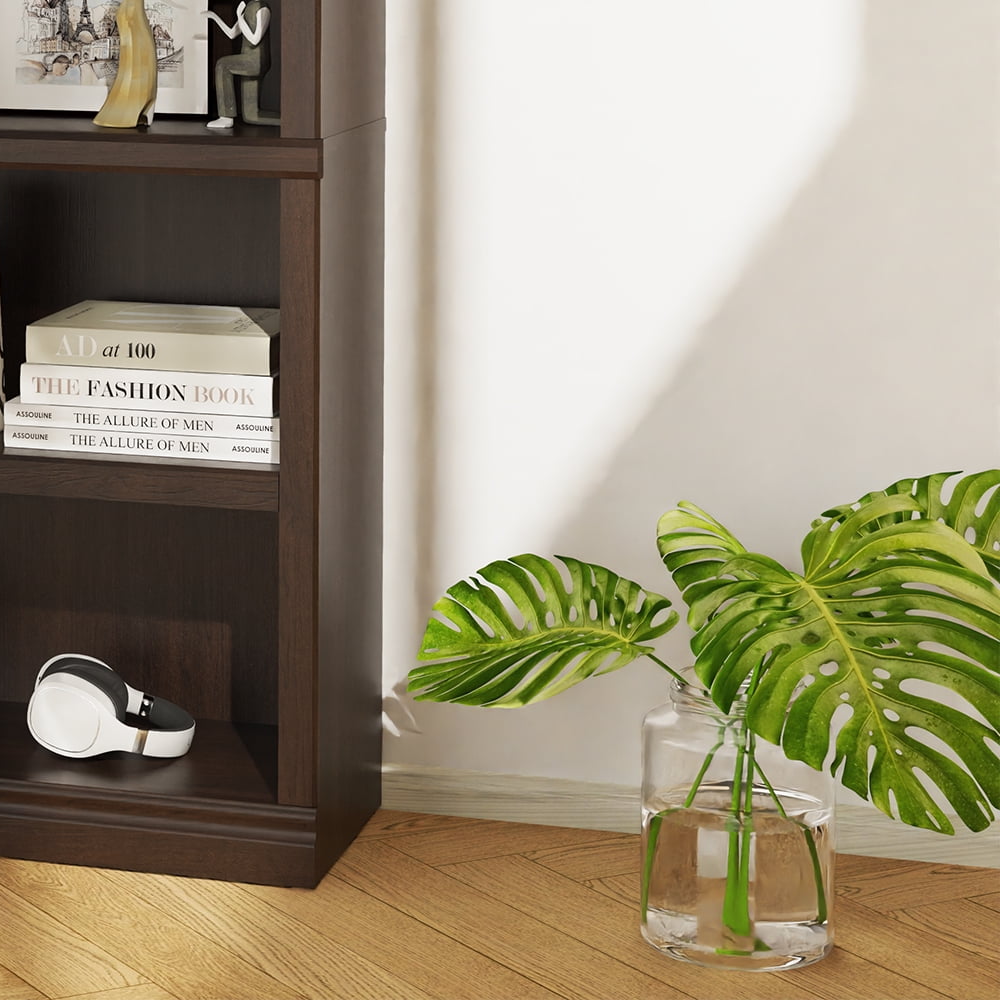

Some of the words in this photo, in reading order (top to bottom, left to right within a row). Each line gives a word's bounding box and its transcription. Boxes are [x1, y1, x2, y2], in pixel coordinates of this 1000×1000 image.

[56, 334, 98, 358] AD
[102, 344, 120, 358] at
[127, 342, 156, 359] 100
[31, 376, 80, 395] THE
[88, 379, 187, 401] FASHION
[194, 385, 255, 405] BOOK
[16, 411, 52, 419] ASSOULINE
[73, 412, 100, 425] THE
[103, 415, 158, 429] ALLURE
[161, 417, 179, 430] OF
[183, 419, 214, 431] MEN
[235, 424, 274, 432] ASSOULINE
[12, 432, 48, 440] ASSOULINE
[70, 434, 97, 446] THE
[99, 436, 153, 449] ALLURE
[157, 439, 175, 451] OF
[179, 440, 210, 453] MEN
[231, 445, 269, 454] ASSOULINE
